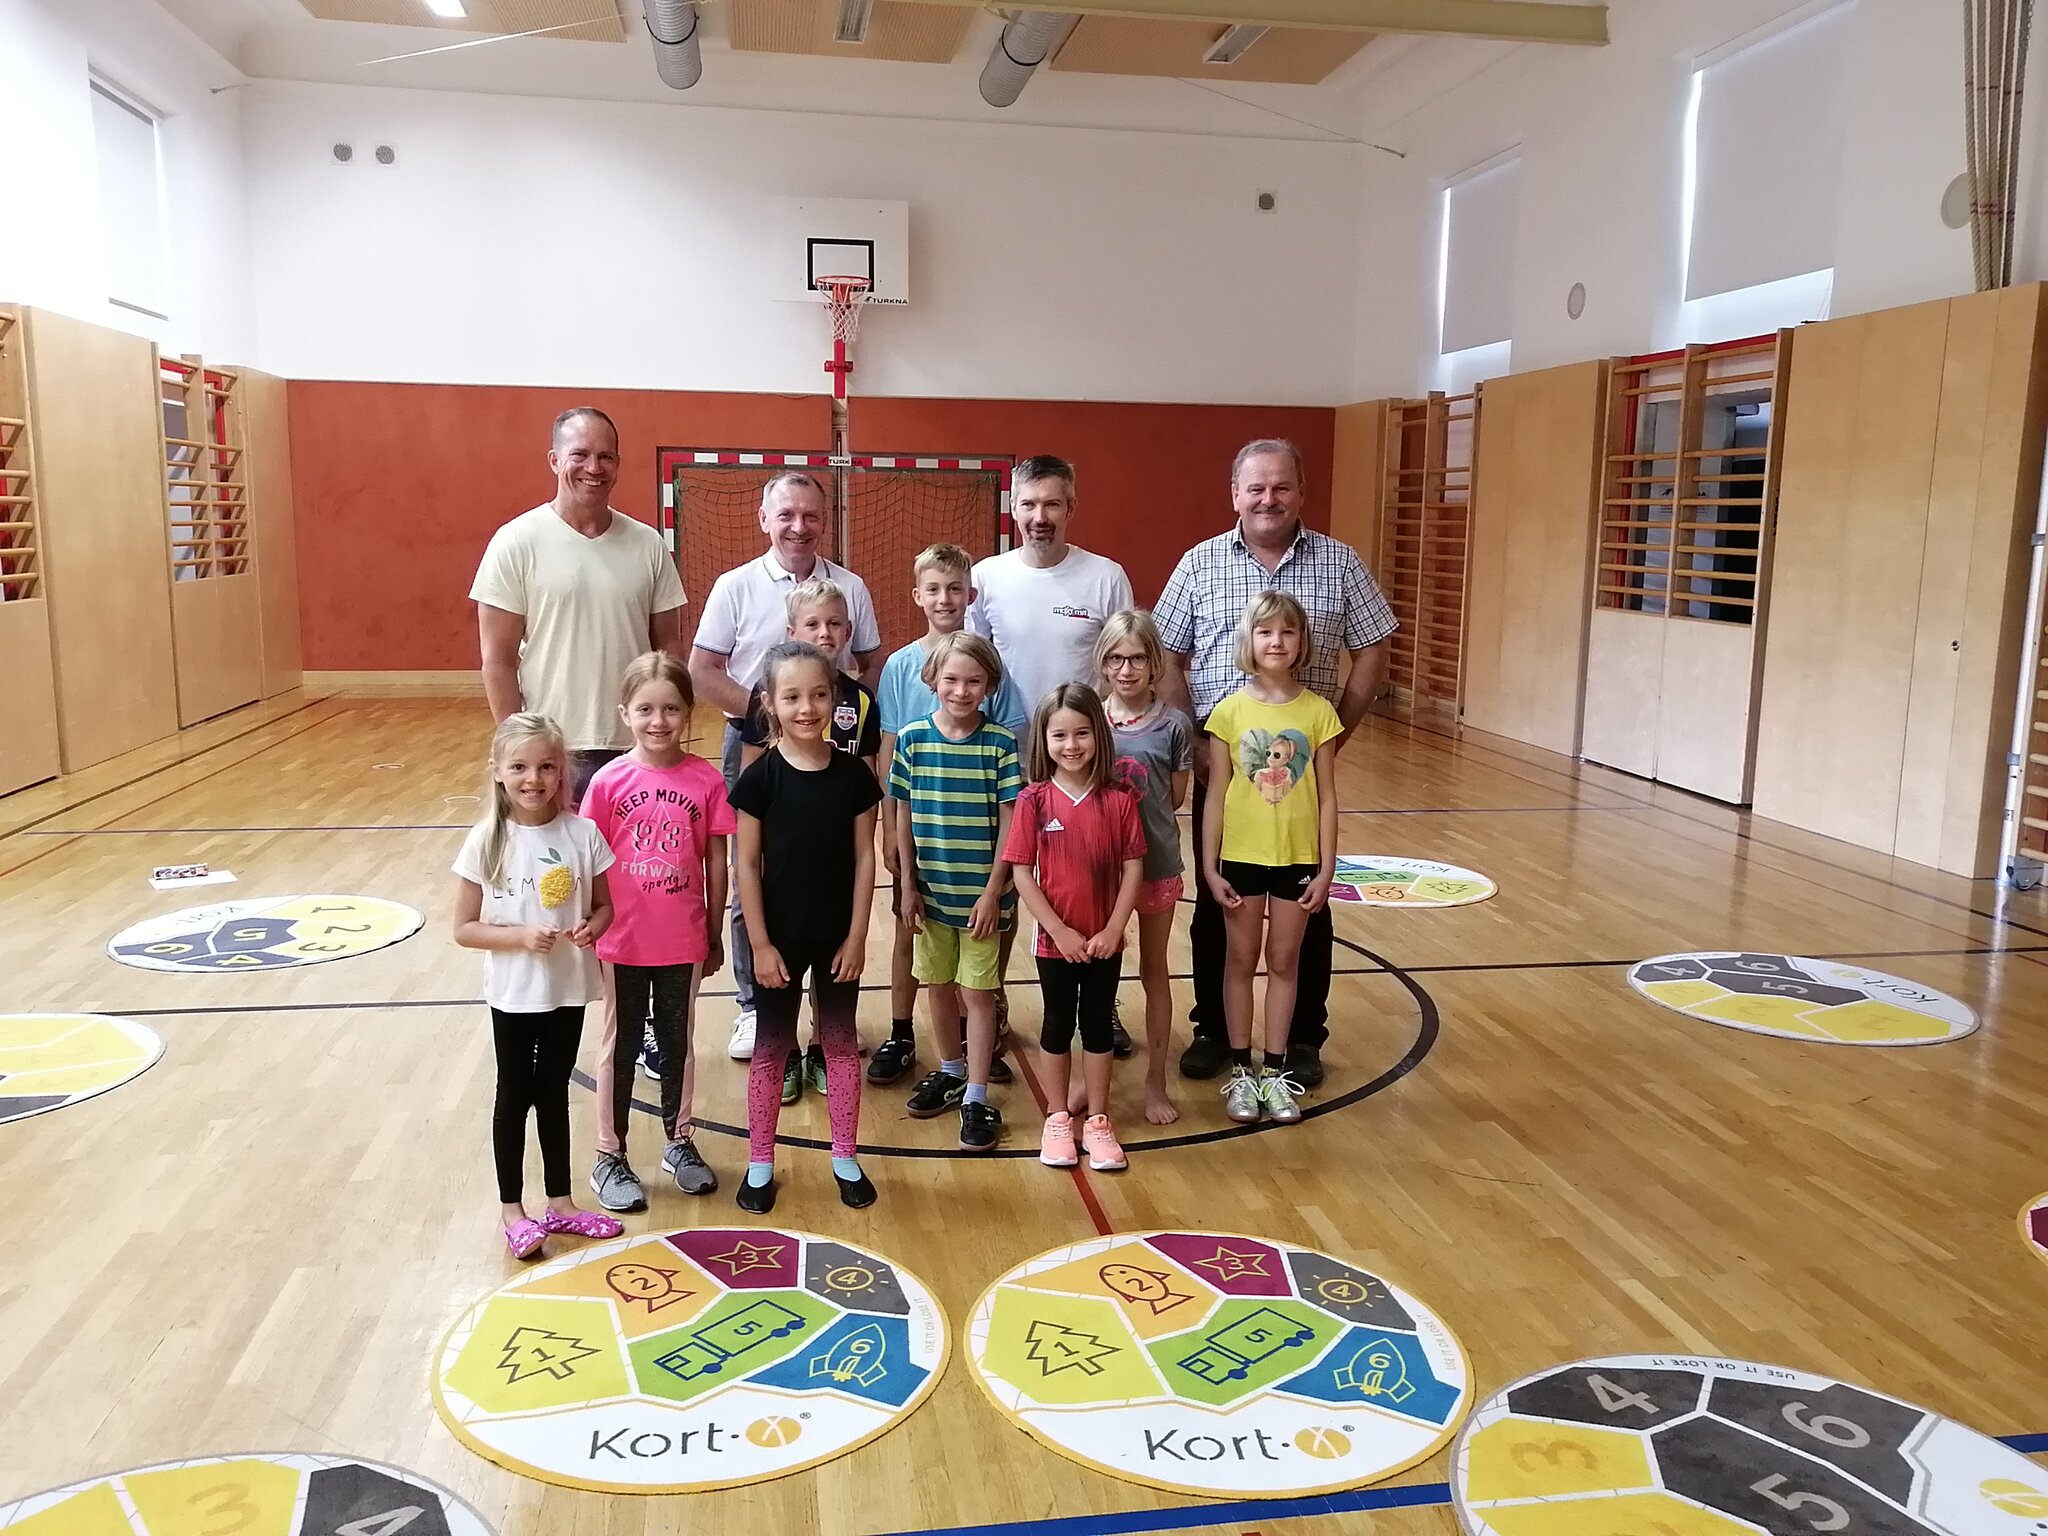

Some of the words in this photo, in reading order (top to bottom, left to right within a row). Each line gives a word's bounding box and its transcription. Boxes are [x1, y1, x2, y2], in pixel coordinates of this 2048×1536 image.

[615, 790, 650, 821] KEEP
[656, 788, 703, 823] MOVING
[233, 927, 268, 943] 5
[1652, 964, 1697, 977] 4
[1761, 980, 1809, 995] 5
[740, 1250, 761, 1264] 3
[1227, 1257, 1246, 1271] 3
[630, 1276, 658, 1291] 2
[835, 1270, 859, 1285] 4
[1127, 1278, 1153, 1292] 2
[1330, 1283, 1351, 1297] 4
[733, 1320, 764, 1336] 5
[1244, 1327, 1273, 1344] 5
[850, 1337, 876, 1354] 6
[1054, 1340, 1080, 1357] 1
[531, 1346, 557, 1363] 1
[1368, 1352, 1392, 1369] 6
[1652, 1358, 1665, 1366] IT
[1670, 1358, 1709, 1369] LOSE
[1714, 1361, 1737, 1371] OR
[1744, 1365, 1758, 1374] IT
[1766, 1368, 1796, 1381] USE
[1586, 1373, 1661, 1415] 4
[1780, 1400, 1871, 1449] 6
[1509, 1437, 1598, 1474] 3
[187, 1482, 261, 1536] 3
[1748, 1472, 1851, 1532] 5
[334, 1504, 426, 1536] 4
